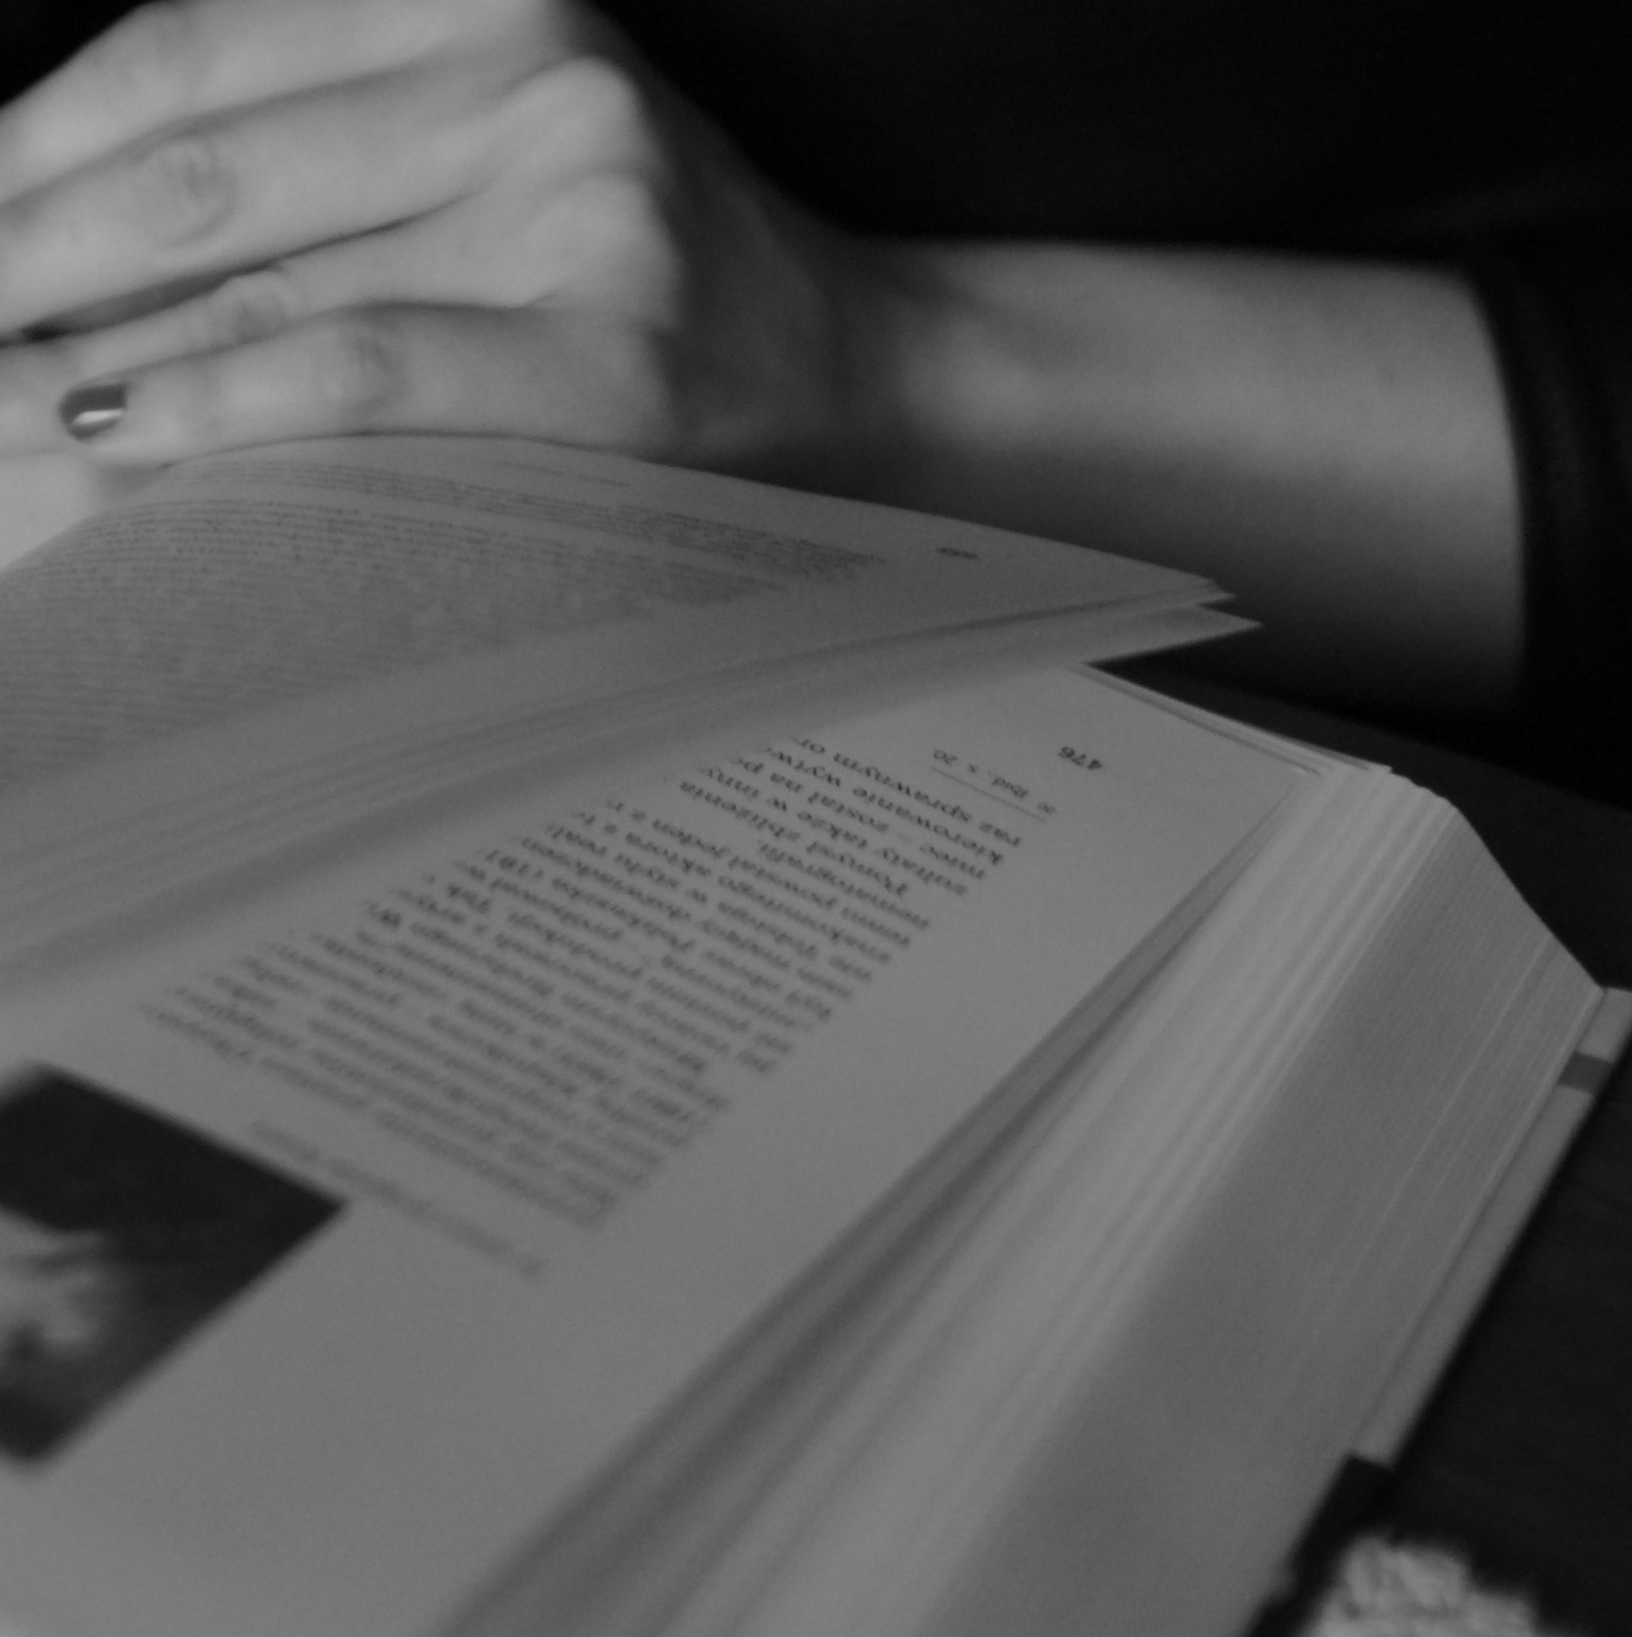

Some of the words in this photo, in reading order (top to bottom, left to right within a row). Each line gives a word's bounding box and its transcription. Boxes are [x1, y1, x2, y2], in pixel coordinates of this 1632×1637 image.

[1056, 745, 1104, 771] 476
[679, 780, 800, 842] zbliżenia
[806, 790, 889, 833] został
[832, 752, 972, 823] sprawnym
[796, 811, 867, 850] także
[852, 787, 1003, 866] kierowanie
[977, 820, 1021, 848] raz
[805, 840, 908, 898] Pomysł
